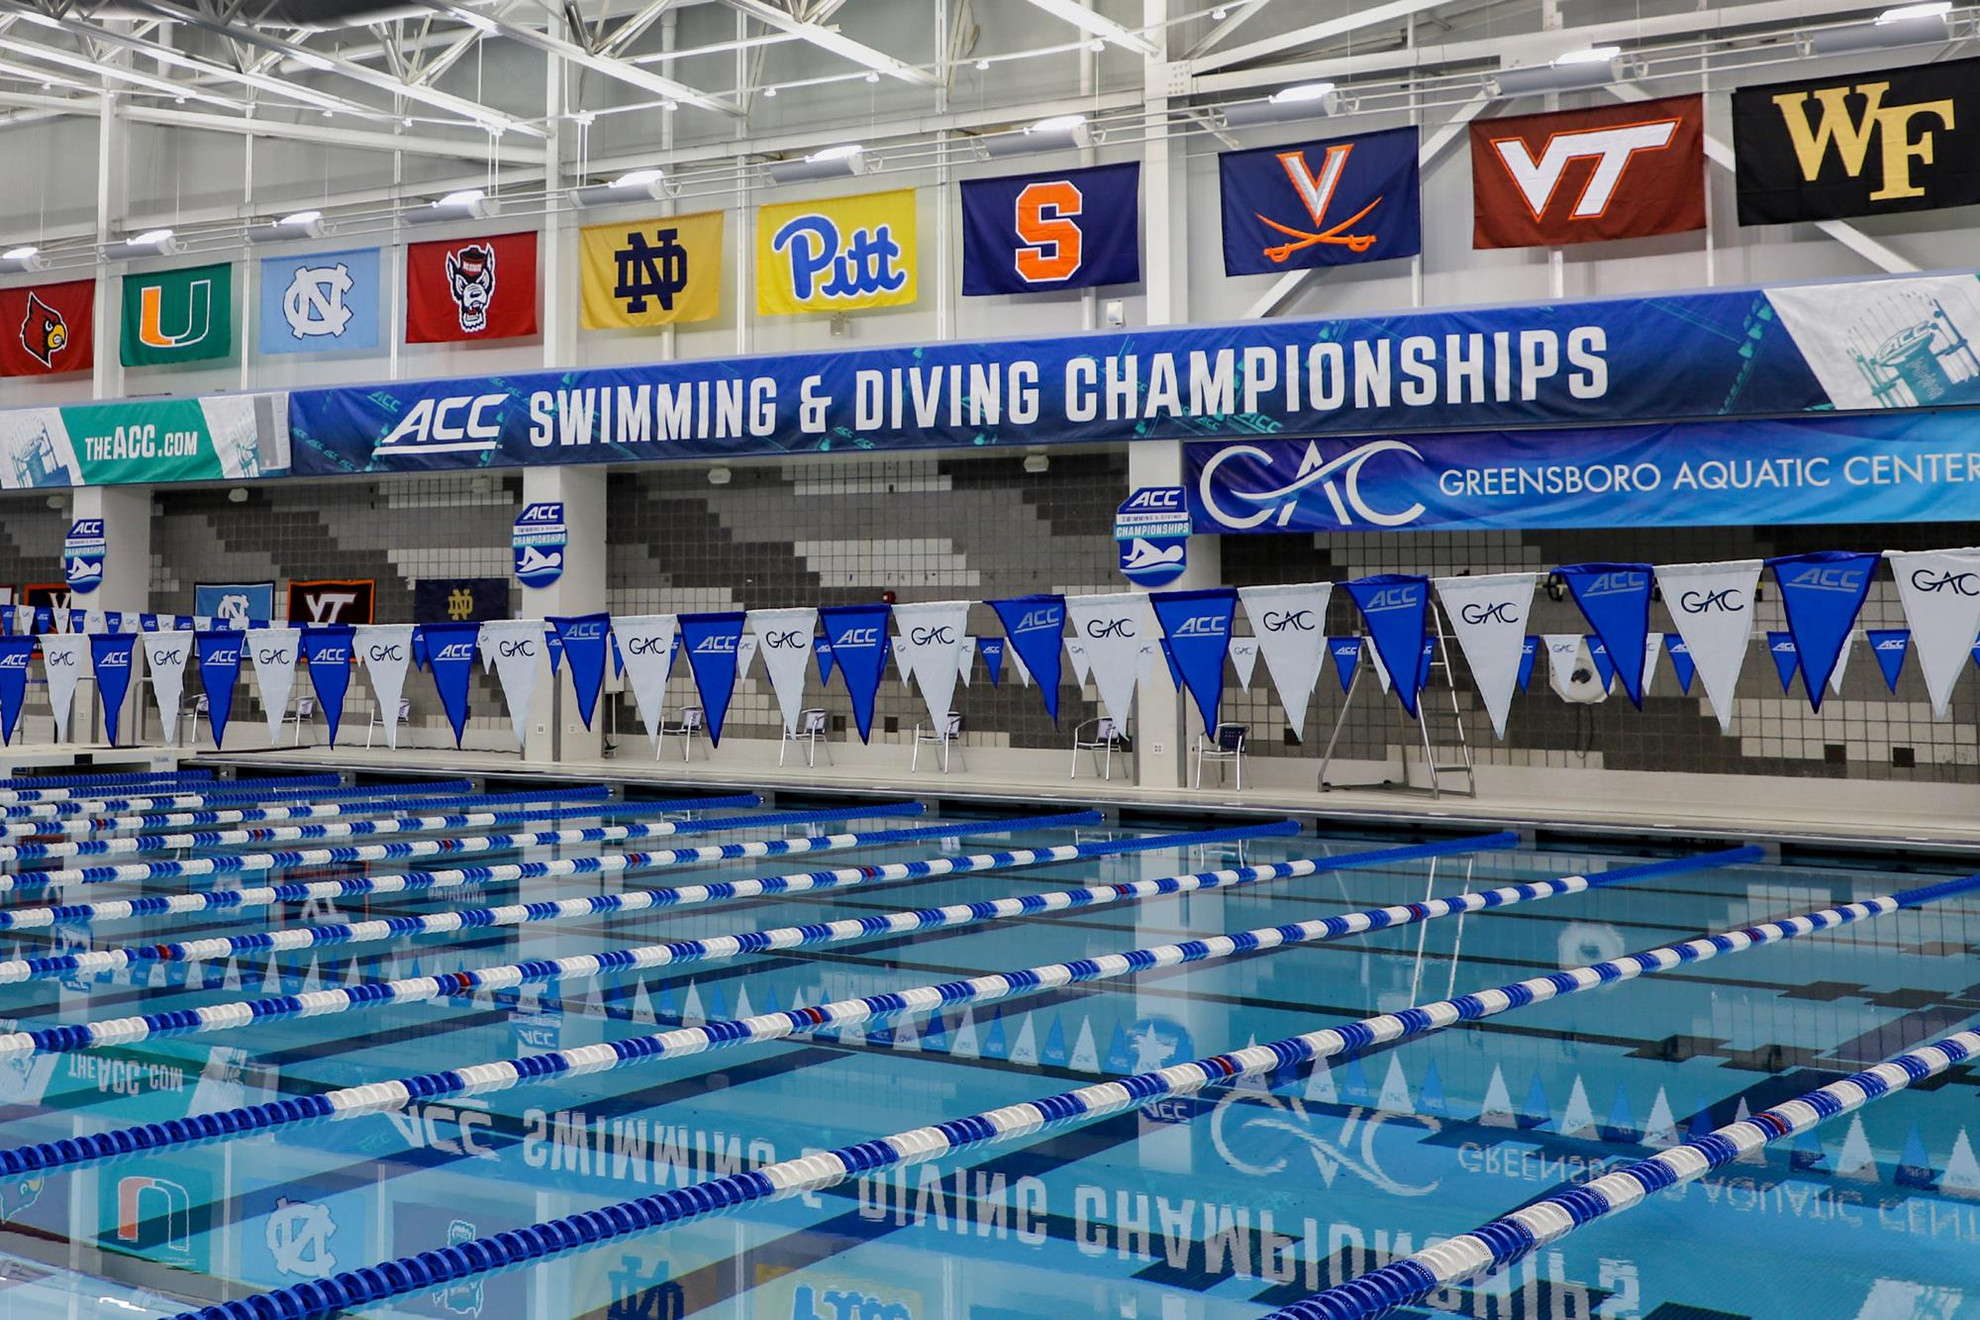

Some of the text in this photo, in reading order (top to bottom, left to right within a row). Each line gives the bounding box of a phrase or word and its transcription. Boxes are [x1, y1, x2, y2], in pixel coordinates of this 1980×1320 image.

[1772, 81, 1955, 201] WF
[1490, 117, 1682, 222] VT
[1276, 143, 1355, 227] V
[1015, 180, 1082, 282] S
[774, 213, 906, 300] Pitt
[140, 279, 211, 347] U
[381, 326, 1609, 448] ACC SWIMMING & DIVING CHAMPIONSHIPS
[1439, 462, 1661, 496] GREENSBORO
[1673, 457, 1830, 490] AQUATIC
[1844, 452, 1980, 486] CENTER
[1129, 490, 1181, 507] ACC
[523, 505, 560, 520] ACC
[73, 521, 102, 534] ACC
[1116, 523, 1189, 538] CHAMPIONSHIPS
[1587, 571, 1646, 593] ACC
[1792, 567, 1863, 590] ACC
[1911, 569, 1980, 597] GAC
[1367, 586, 1418, 608] ACC
[1681, 588, 1744, 613] GAC
[1017, 607, 1060, 628] ACC
[1263, 610, 1316, 631] GAC
[1461, 602, 1519, 625] GAC
[566, 623, 600, 637] ACC
[1087, 618, 1136, 638] GAC
[1176, 615, 1227, 633] ACC
[698, 635, 738, 649] ACC
[766, 630, 806, 649] GAC
[836, 628, 879, 643] ACC
[911, 626, 955, 646] GAC
[1876, 640, 1905, 649] ACC
[313, 648, 346, 661] ACC
[370, 645, 403, 661] GAC
[438, 644, 474, 657] ACC
[500, 639, 535, 657] GAC
[629, 637, 666, 655] GAC
[0, 654, 28, 665] ACC
[50, 651, 75, 666] GAC
[101, 652, 129, 664] ACC
[154, 650, 182, 666] GAC
[208, 650, 237, 662] ACC
[259, 649, 290, 665] GAC
